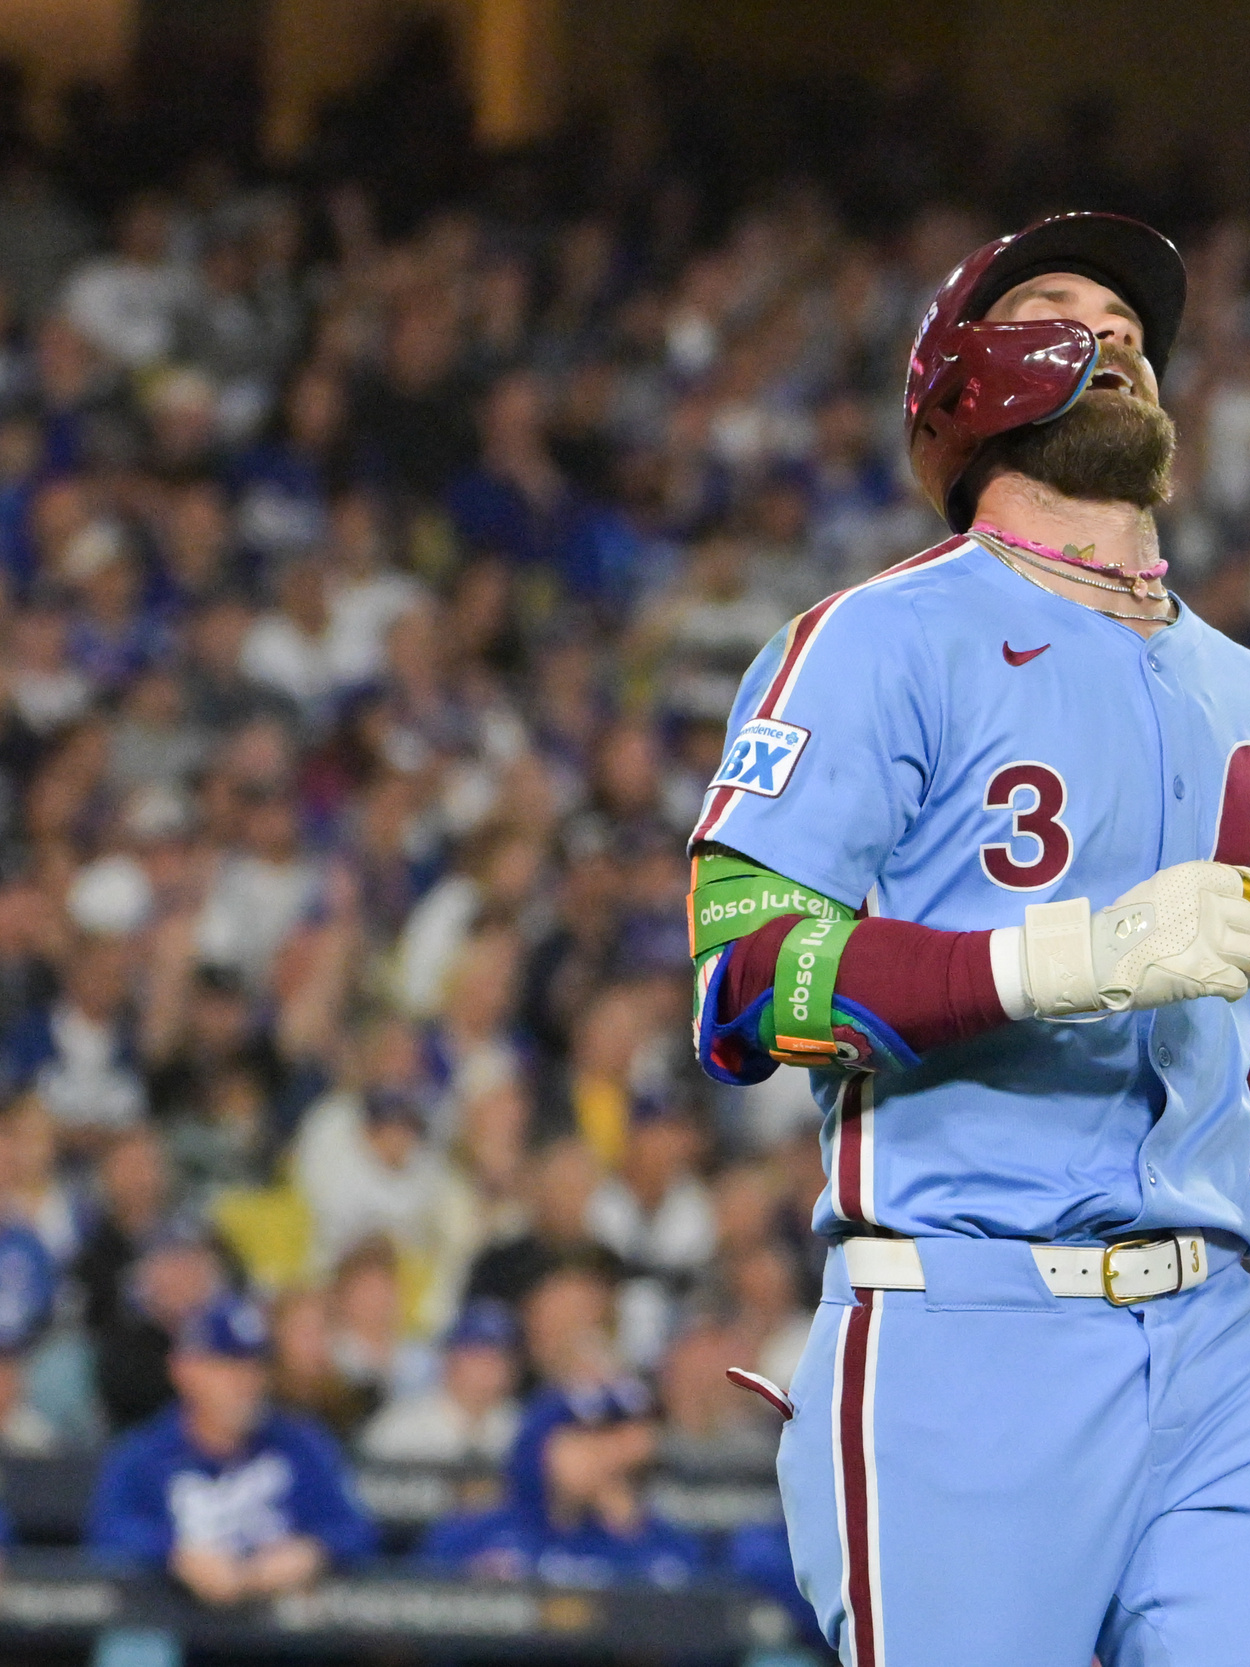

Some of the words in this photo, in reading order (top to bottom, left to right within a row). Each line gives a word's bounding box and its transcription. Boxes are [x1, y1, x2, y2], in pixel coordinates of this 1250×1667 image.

[716, 740, 792, 791] BX
[980, 760, 1073, 892] 3
[1190, 1240, 1200, 1273] 3
